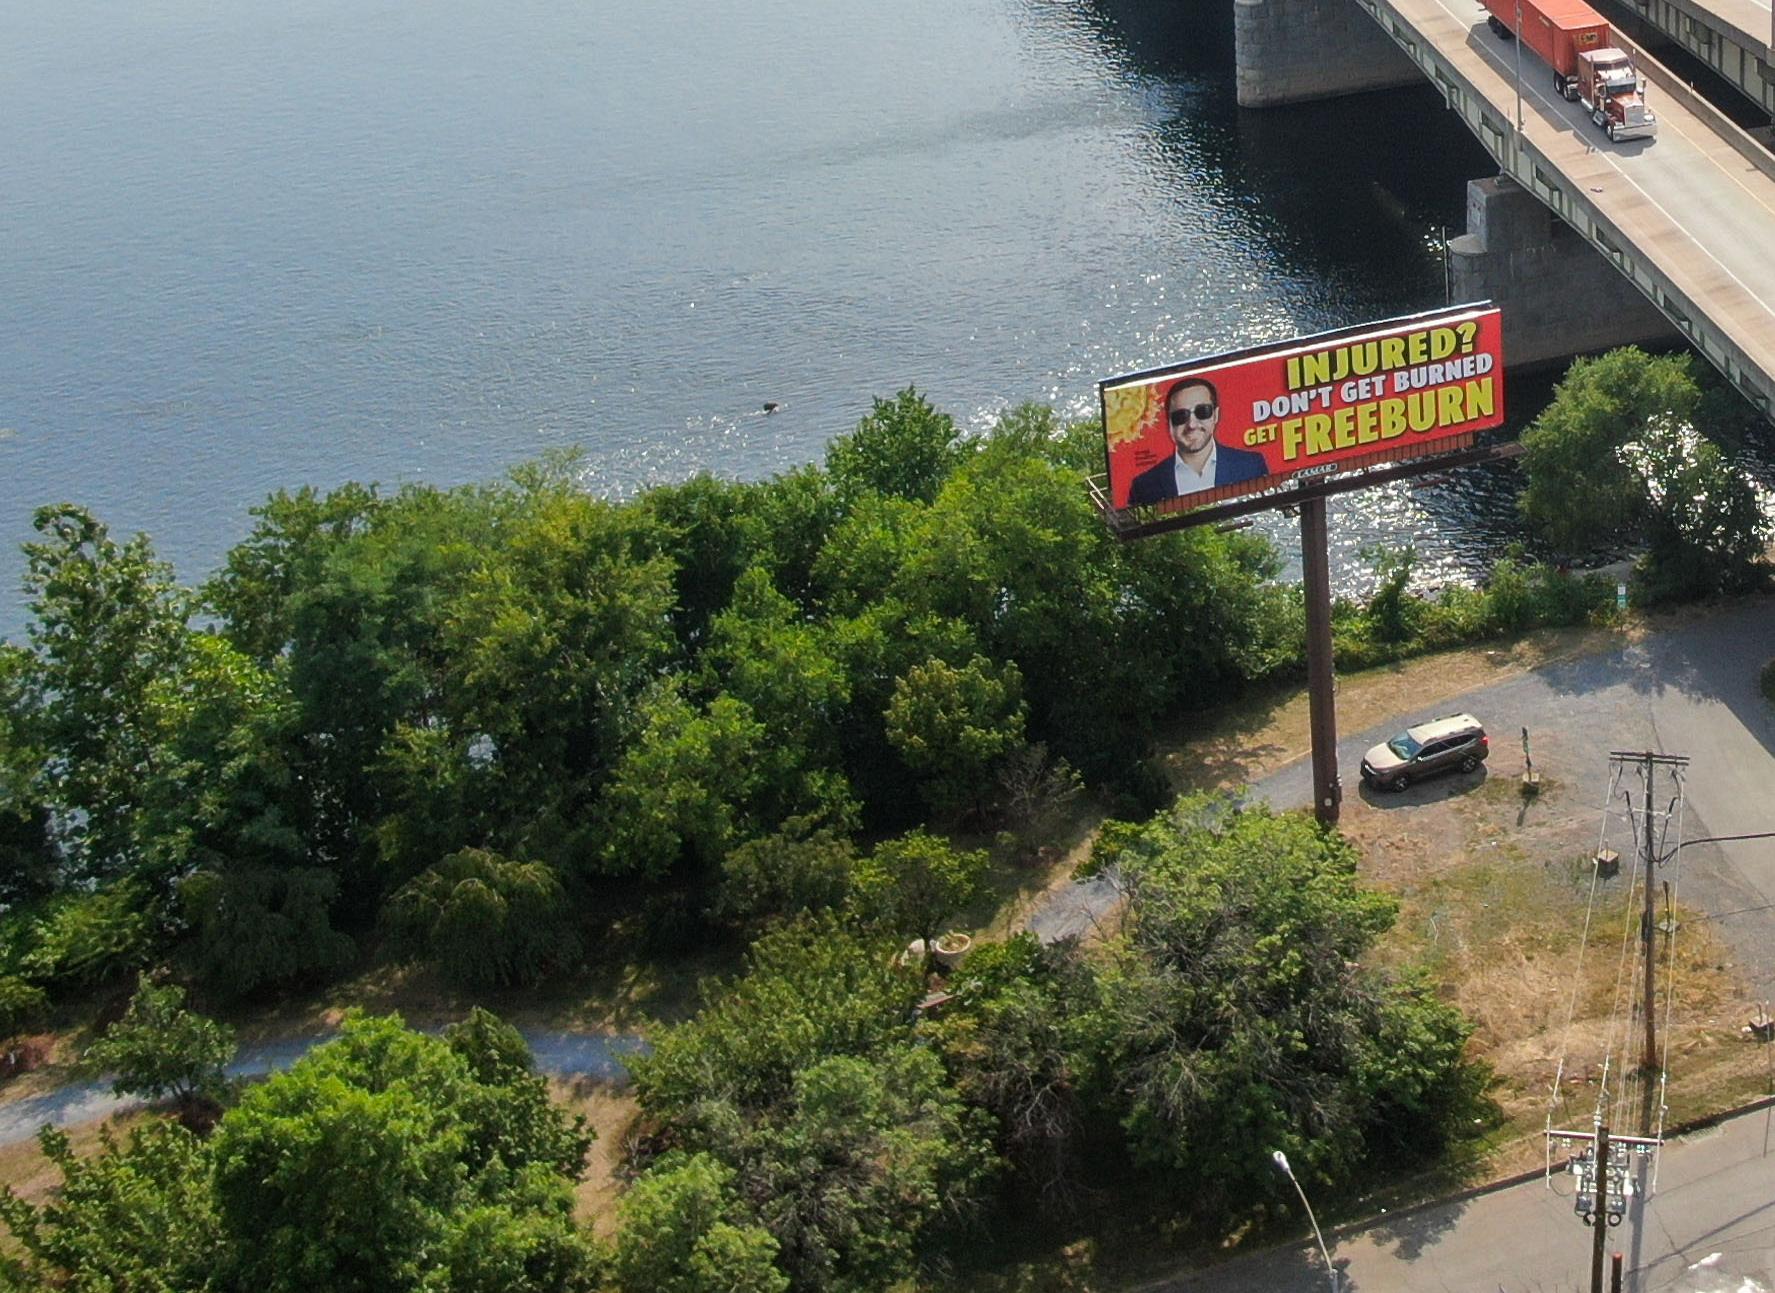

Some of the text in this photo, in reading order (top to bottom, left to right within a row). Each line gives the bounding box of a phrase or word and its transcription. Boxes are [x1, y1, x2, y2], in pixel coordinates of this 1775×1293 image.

[1253, 353, 1493, 422] DON'T GET BURNED
[1287, 322, 1477, 390] INJURED?
[1243, 377, 1494, 461] GET FREEBURN
